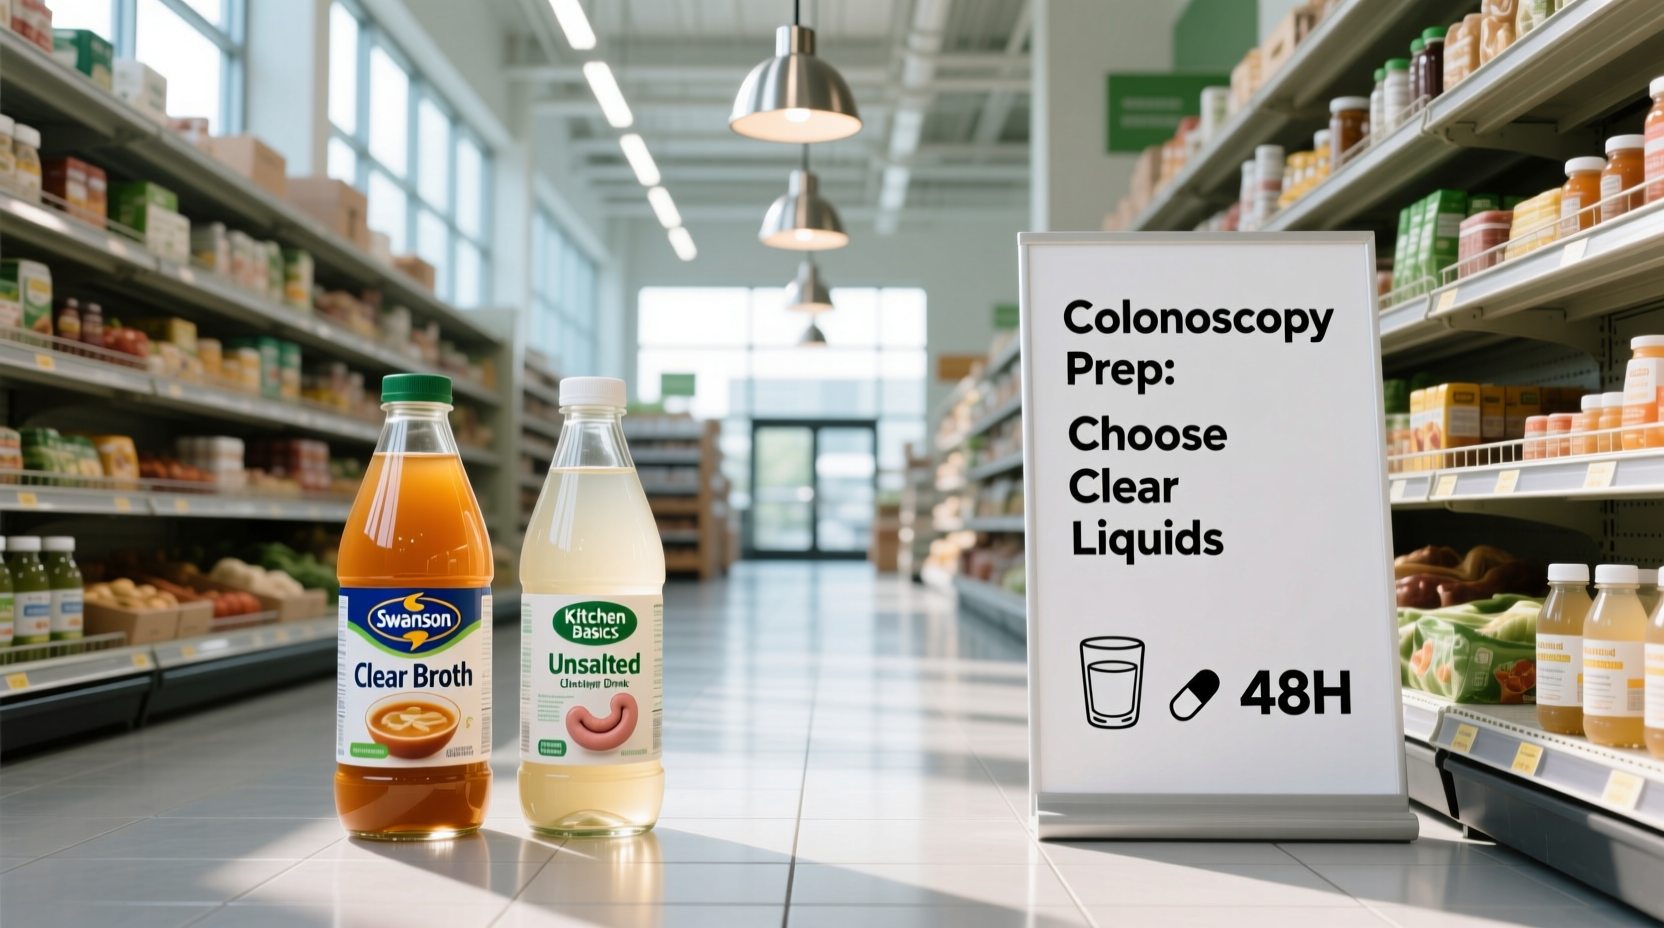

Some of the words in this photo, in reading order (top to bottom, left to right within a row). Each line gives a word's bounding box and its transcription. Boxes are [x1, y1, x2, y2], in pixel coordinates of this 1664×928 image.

[1064, 299, 1334, 343] Colonoscopy
[1067, 352, 1175, 394] Prep:
[1069, 415, 1227, 451] Choose
[1069, 468, 1179, 504] Clear
[1073, 519, 1224, 565] Liquids
[376, 608, 452, 629] Swanson
[564, 607, 626, 625] Kitchen
[354, 662, 408, 689] Clear
[413, 660, 473, 688] Broth
[548, 652, 641, 675] Unsalted
[1240, 669, 1352, 715] 48H
